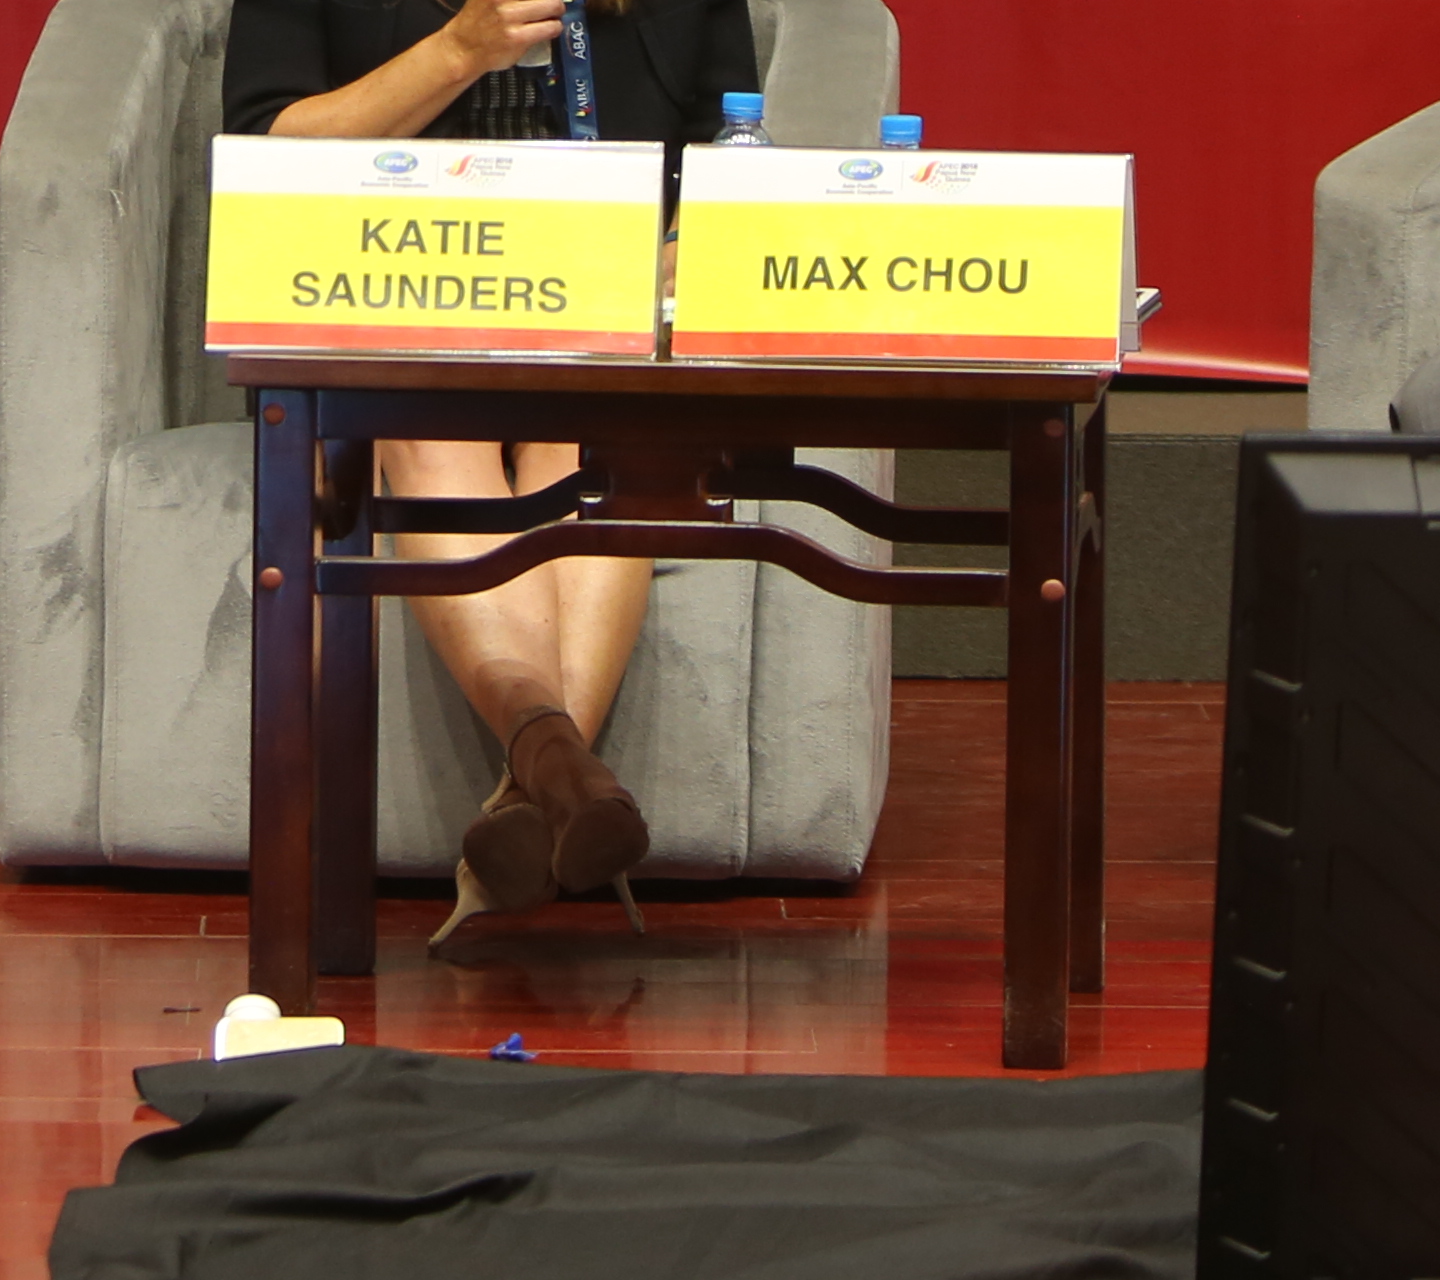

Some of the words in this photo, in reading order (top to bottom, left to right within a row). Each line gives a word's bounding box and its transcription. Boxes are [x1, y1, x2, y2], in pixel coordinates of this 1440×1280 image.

[570, 21, 587, 60] ABAC
[575, 79, 589, 110] ABAC
[849, 165, 873, 174] APEC
[360, 218, 506, 256] KATIE
[291, 270, 569, 313] SAUNDERS
[762, 255, 870, 291] MAX
[885, 256, 1030, 295] CHOU
